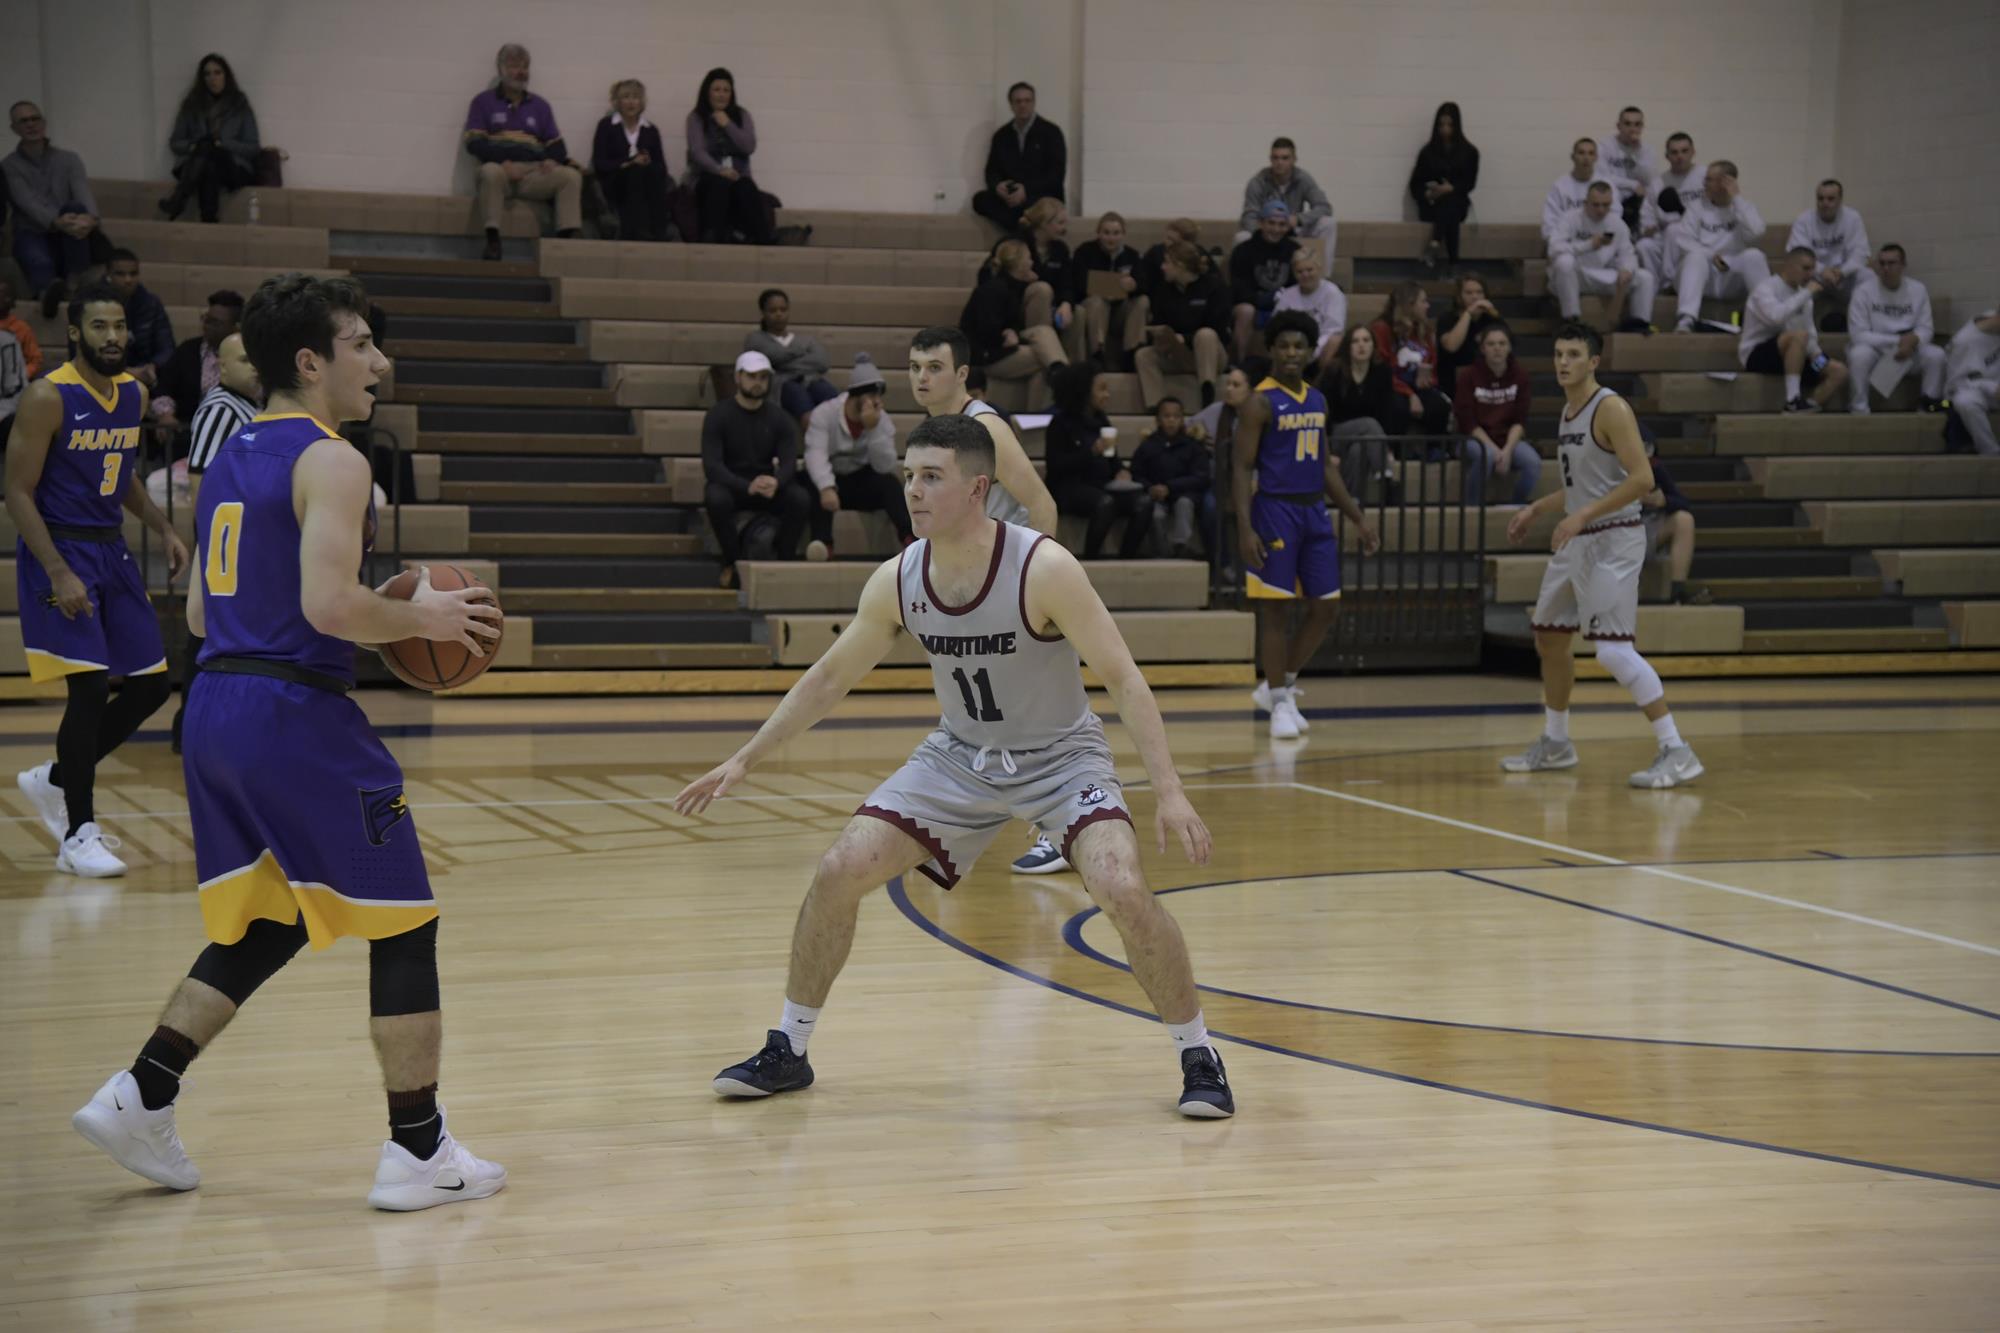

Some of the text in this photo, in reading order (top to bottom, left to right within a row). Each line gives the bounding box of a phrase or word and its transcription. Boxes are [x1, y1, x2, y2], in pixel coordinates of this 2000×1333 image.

[1296, 429, 1319, 461] 14
[100, 452, 123, 496] 3
[205, 502, 244, 596] 0
[918, 631, 1016, 657] MARITIME
[952, 667, 1004, 722] 11
